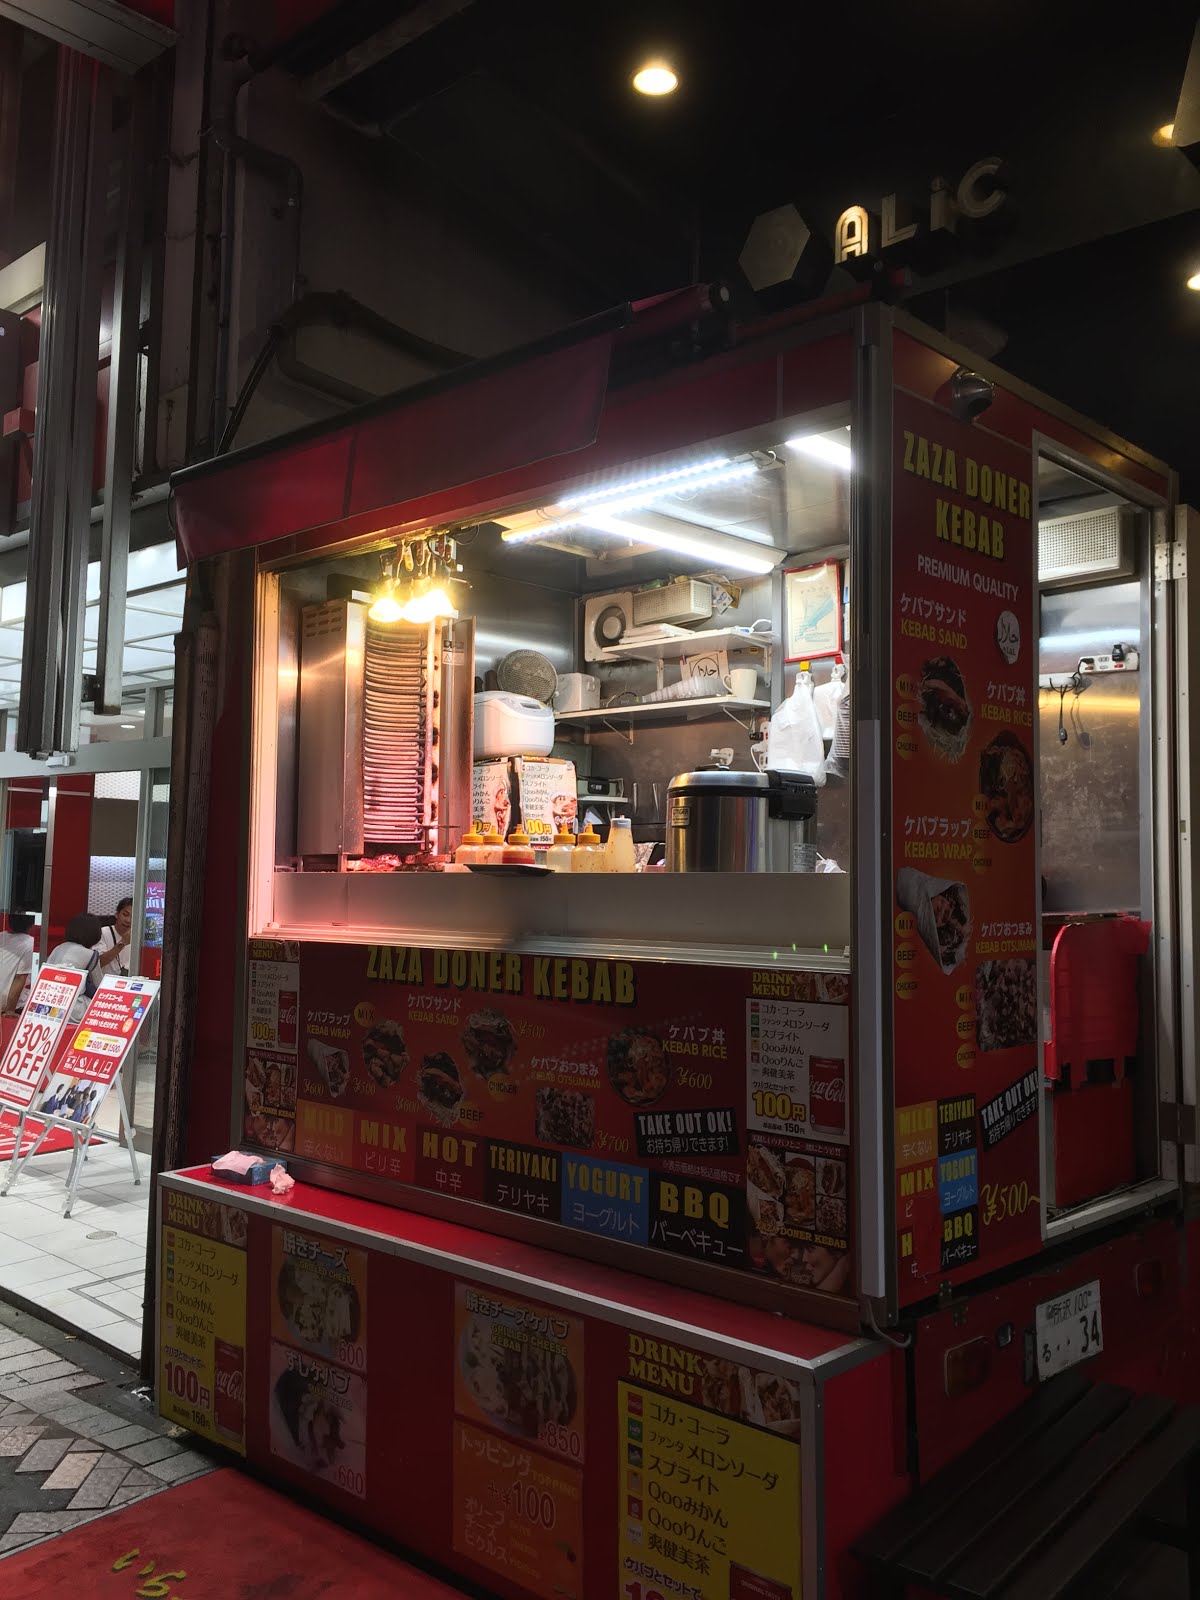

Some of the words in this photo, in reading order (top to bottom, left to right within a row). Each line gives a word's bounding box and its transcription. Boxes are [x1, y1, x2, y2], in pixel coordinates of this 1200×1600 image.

[903, 430, 958, 490] ZAZA
[965, 457, 1031, 520] DONER
[935, 498, 1005, 560] KEBAB
[917, 554, 970, 588] PREMIUM
[973, 575, 1019, 602] QUALITY
[901, 618, 936, 641] KEBAB
[938, 629, 968, 650] SAND
[899, 681, 914, 693] MIX
[897, 710, 917, 723] BEEF
[981, 703, 1010, 723] KEBAB
[1012, 708, 1033, 728] RICE
[525, 819, 552, 835] 00円
[904, 841, 940, 858] KEBAB
[943, 843, 974, 861] WRAP
[898, 919, 914, 930] MIX
[975, 940, 1000, 954] KEBAB
[367, 945, 423, 983] ZAZA
[434, 948, 523, 992] DONER
[533, 956, 636, 1004] KEBAB
[752, 971, 795, 985] DRINK
[752, 984, 790, 997] MENU
[357, 1010, 375, 1020] MIX
[408, 1010, 434, 1024] KEBAB
[436, 1013, 459, 1026] SAND
[762, 1004, 805, 1016] コカ・コーラ
[17, 1022, 57, 1056] 30%
[306, 1024, 328, 1036] KEBAB
[330, 1026, 351, 1038] WRAP
[762, 1029, 800, 1042] スプライト
[662, 1040, 699, 1056] KEBAB
[701, 1045, 728, 1060] RICE
[761, 1042, 805, 1055] Qooみかん
[761, 1055, 804, 1068] Qooりんご
[6, 1049, 45, 1080] OFF
[487, 1080, 518, 1095] CHICKEN
[557, 1074, 601, 1089] OTSUMAMI
[676, 1066, 713, 1090] ¥600
[459, 1107, 484, 1122] BEEF
[752, 1090, 807, 1121] 100円
[939, 1098, 975, 1125] TERIYAKI
[981, 1105, 1001, 1129] TAKE
[1003, 1088, 1022, 1112] OUT
[303, 1107, 343, 1136] MILD
[638, 1115, 673, 1136] TAKE
[675, 1113, 703, 1134] OUT
[707, 1111, 733, 1132] OK!
[899, 1108, 934, 1133] MILD
[360, 1119, 406, 1152] MIX
[943, 1129, 973, 1150] テリヤキ
[422, 1131, 476, 1167] HOT
[364, 1154, 401, 1176] ピリ辛
[490, 1146, 557, 1182] TERIYAKI
[939, 1155, 976, 1183] YOGURT
[435, 1168, 462, 1192] 中辛
[567, 1162, 644, 1204] YOGURT
[900, 1166, 934, 1197] MIX
[168, 1191, 204, 1216] DRINK
[497, 1185, 549, 1213] テリヤキ
[659, 1180, 730, 1230] BBQ
[168, 1207, 200, 1229] MENU
[573, 1204, 640, 1235] ヨーグルト
[943, 1211, 973, 1243] BBQ
[177, 1235, 217, 1260] コカ・コーラ
[282, 1229, 350, 1272] 焼きチーズ
[651, 1219, 744, 1257] バーベキュー
[780, 1228, 813, 1242] DONER
[814, 1234, 847, 1249] KEBAB
[942, 1242, 977, 1265] バーベキュー
[177, 1273, 211, 1294] スプライト
[176, 1290, 215, 1316] Qooみかん
[1073, 1290, 1089, 1316] 100
[490, 1323, 529, 1344] GRILLED
[530, 1333, 568, 1358] CHEESE
[1080, 1309, 1100, 1352] 34
[490, 1335, 522, 1354] KEBAB
[628, 1333, 703, 1378] DRINK
[164, 1360, 211, 1412] 100円
[628, 1356, 695, 1397] MENU
[649, 1402, 731, 1446] コカ・コーラ
[461, 1429, 532, 1477] トッピング
[648, 1454, 720, 1496] スプライト
[648, 1481, 729, 1530] Qooみかん
[648, 1506, 727, 1557] Qooりんご
[647, 1532, 710, 1576] 爽健美茶
